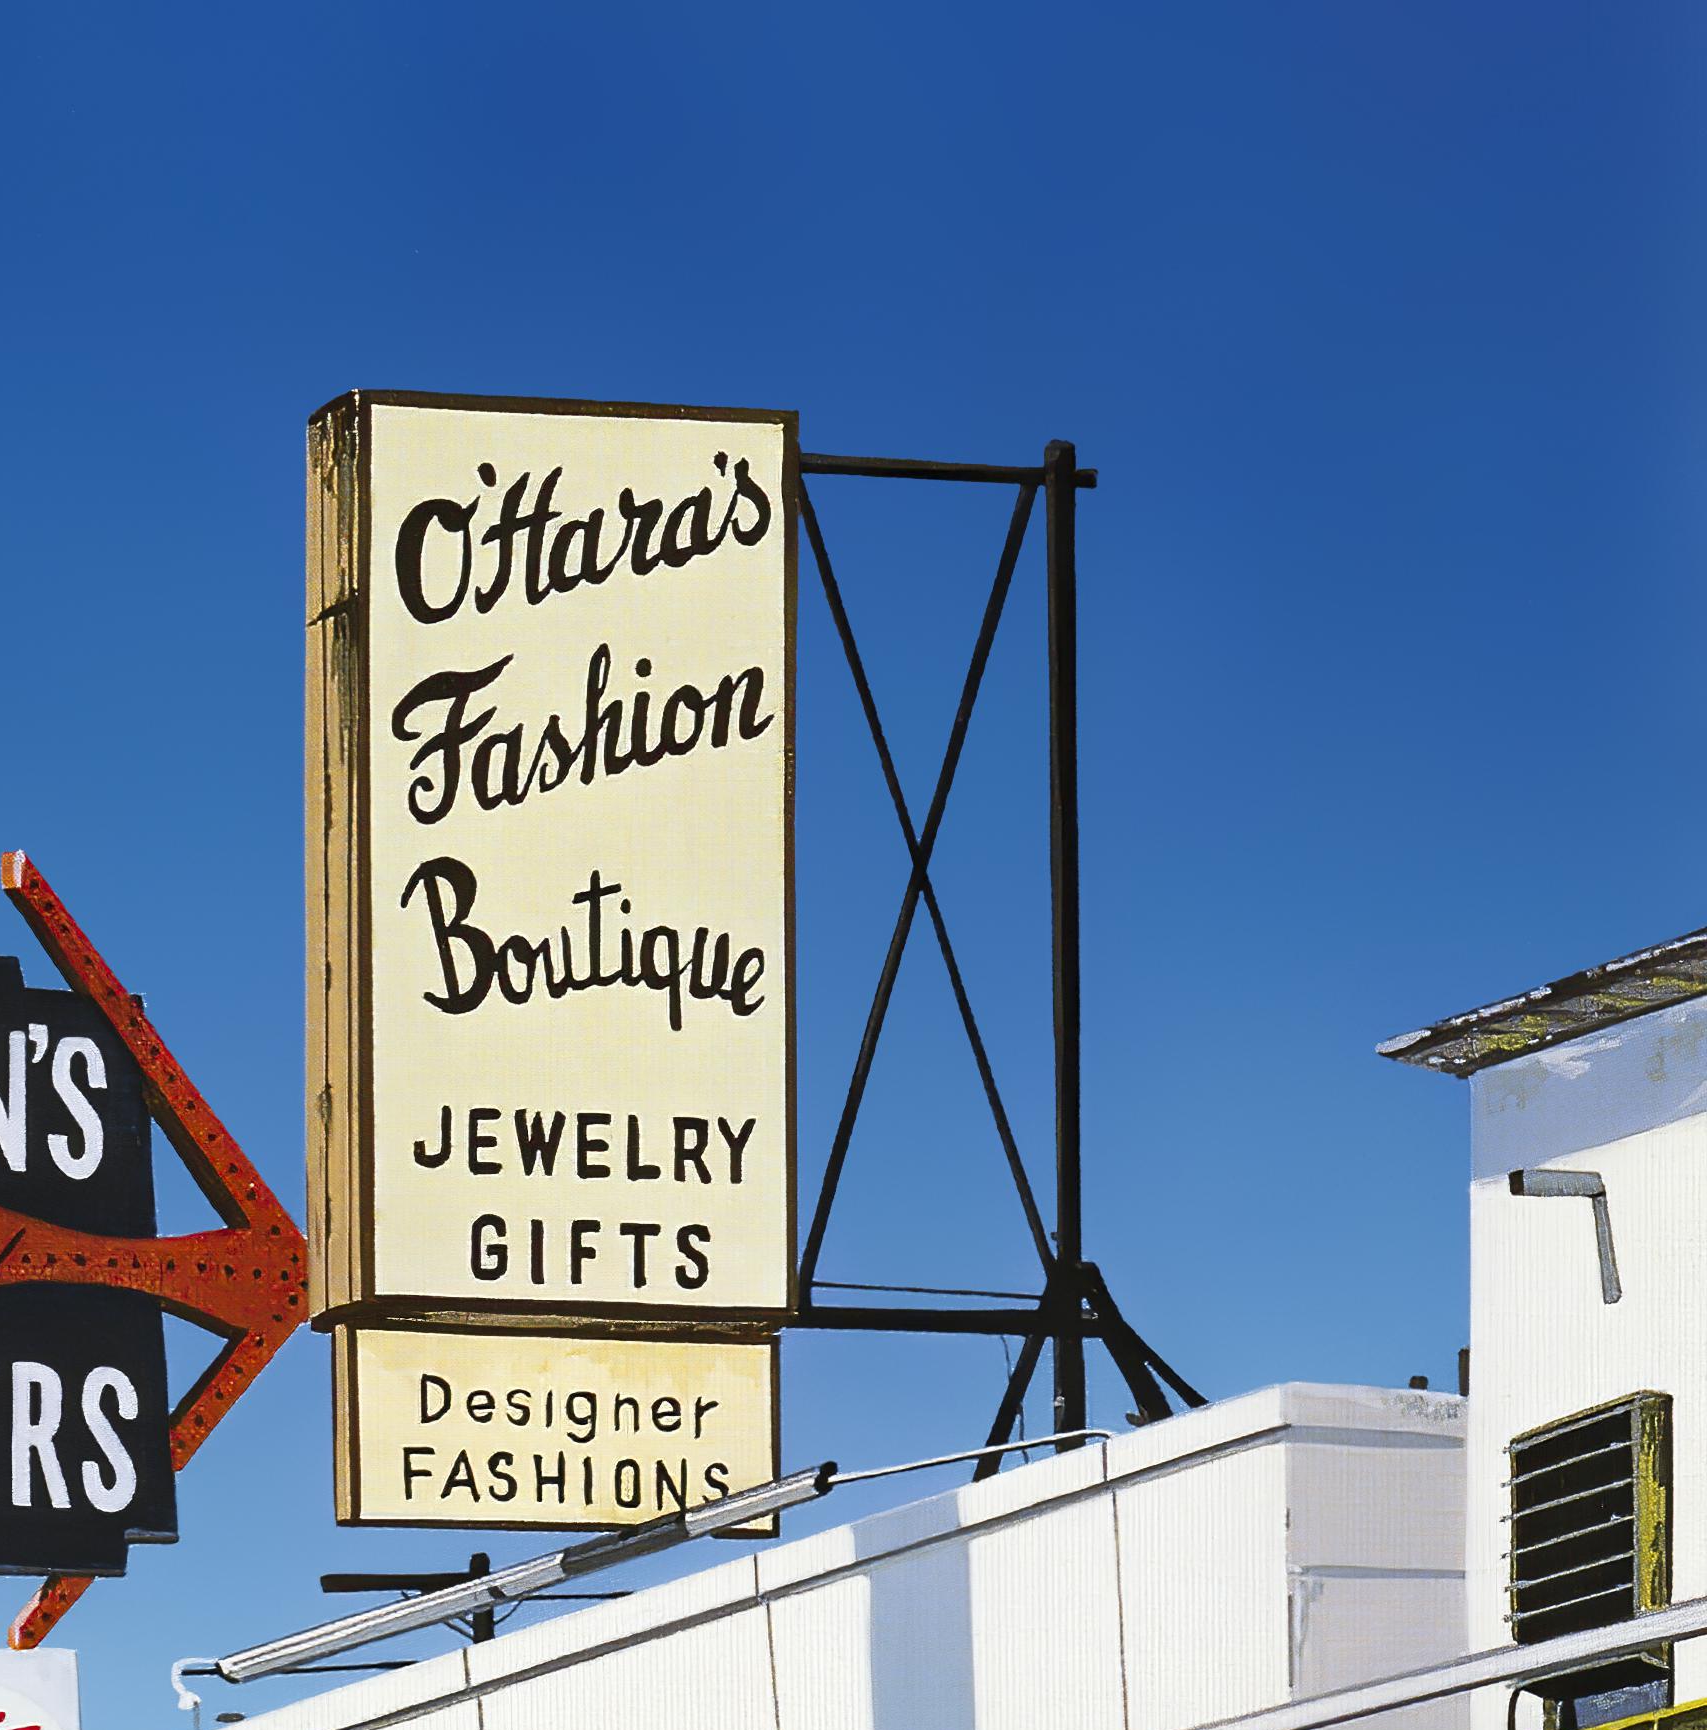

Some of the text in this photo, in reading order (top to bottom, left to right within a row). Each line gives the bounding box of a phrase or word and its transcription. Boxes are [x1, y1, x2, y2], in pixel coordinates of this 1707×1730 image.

[391, 643, 775, 825] Fashion
[400, 856, 766, 1032] Boutique
[413, 1104, 757, 1184] JEWELRY
[470, 1213, 713, 1291] GIFTS
[419, 1373, 719, 1443] Designer
[402, 1446, 730, 1511] FASHIONS
